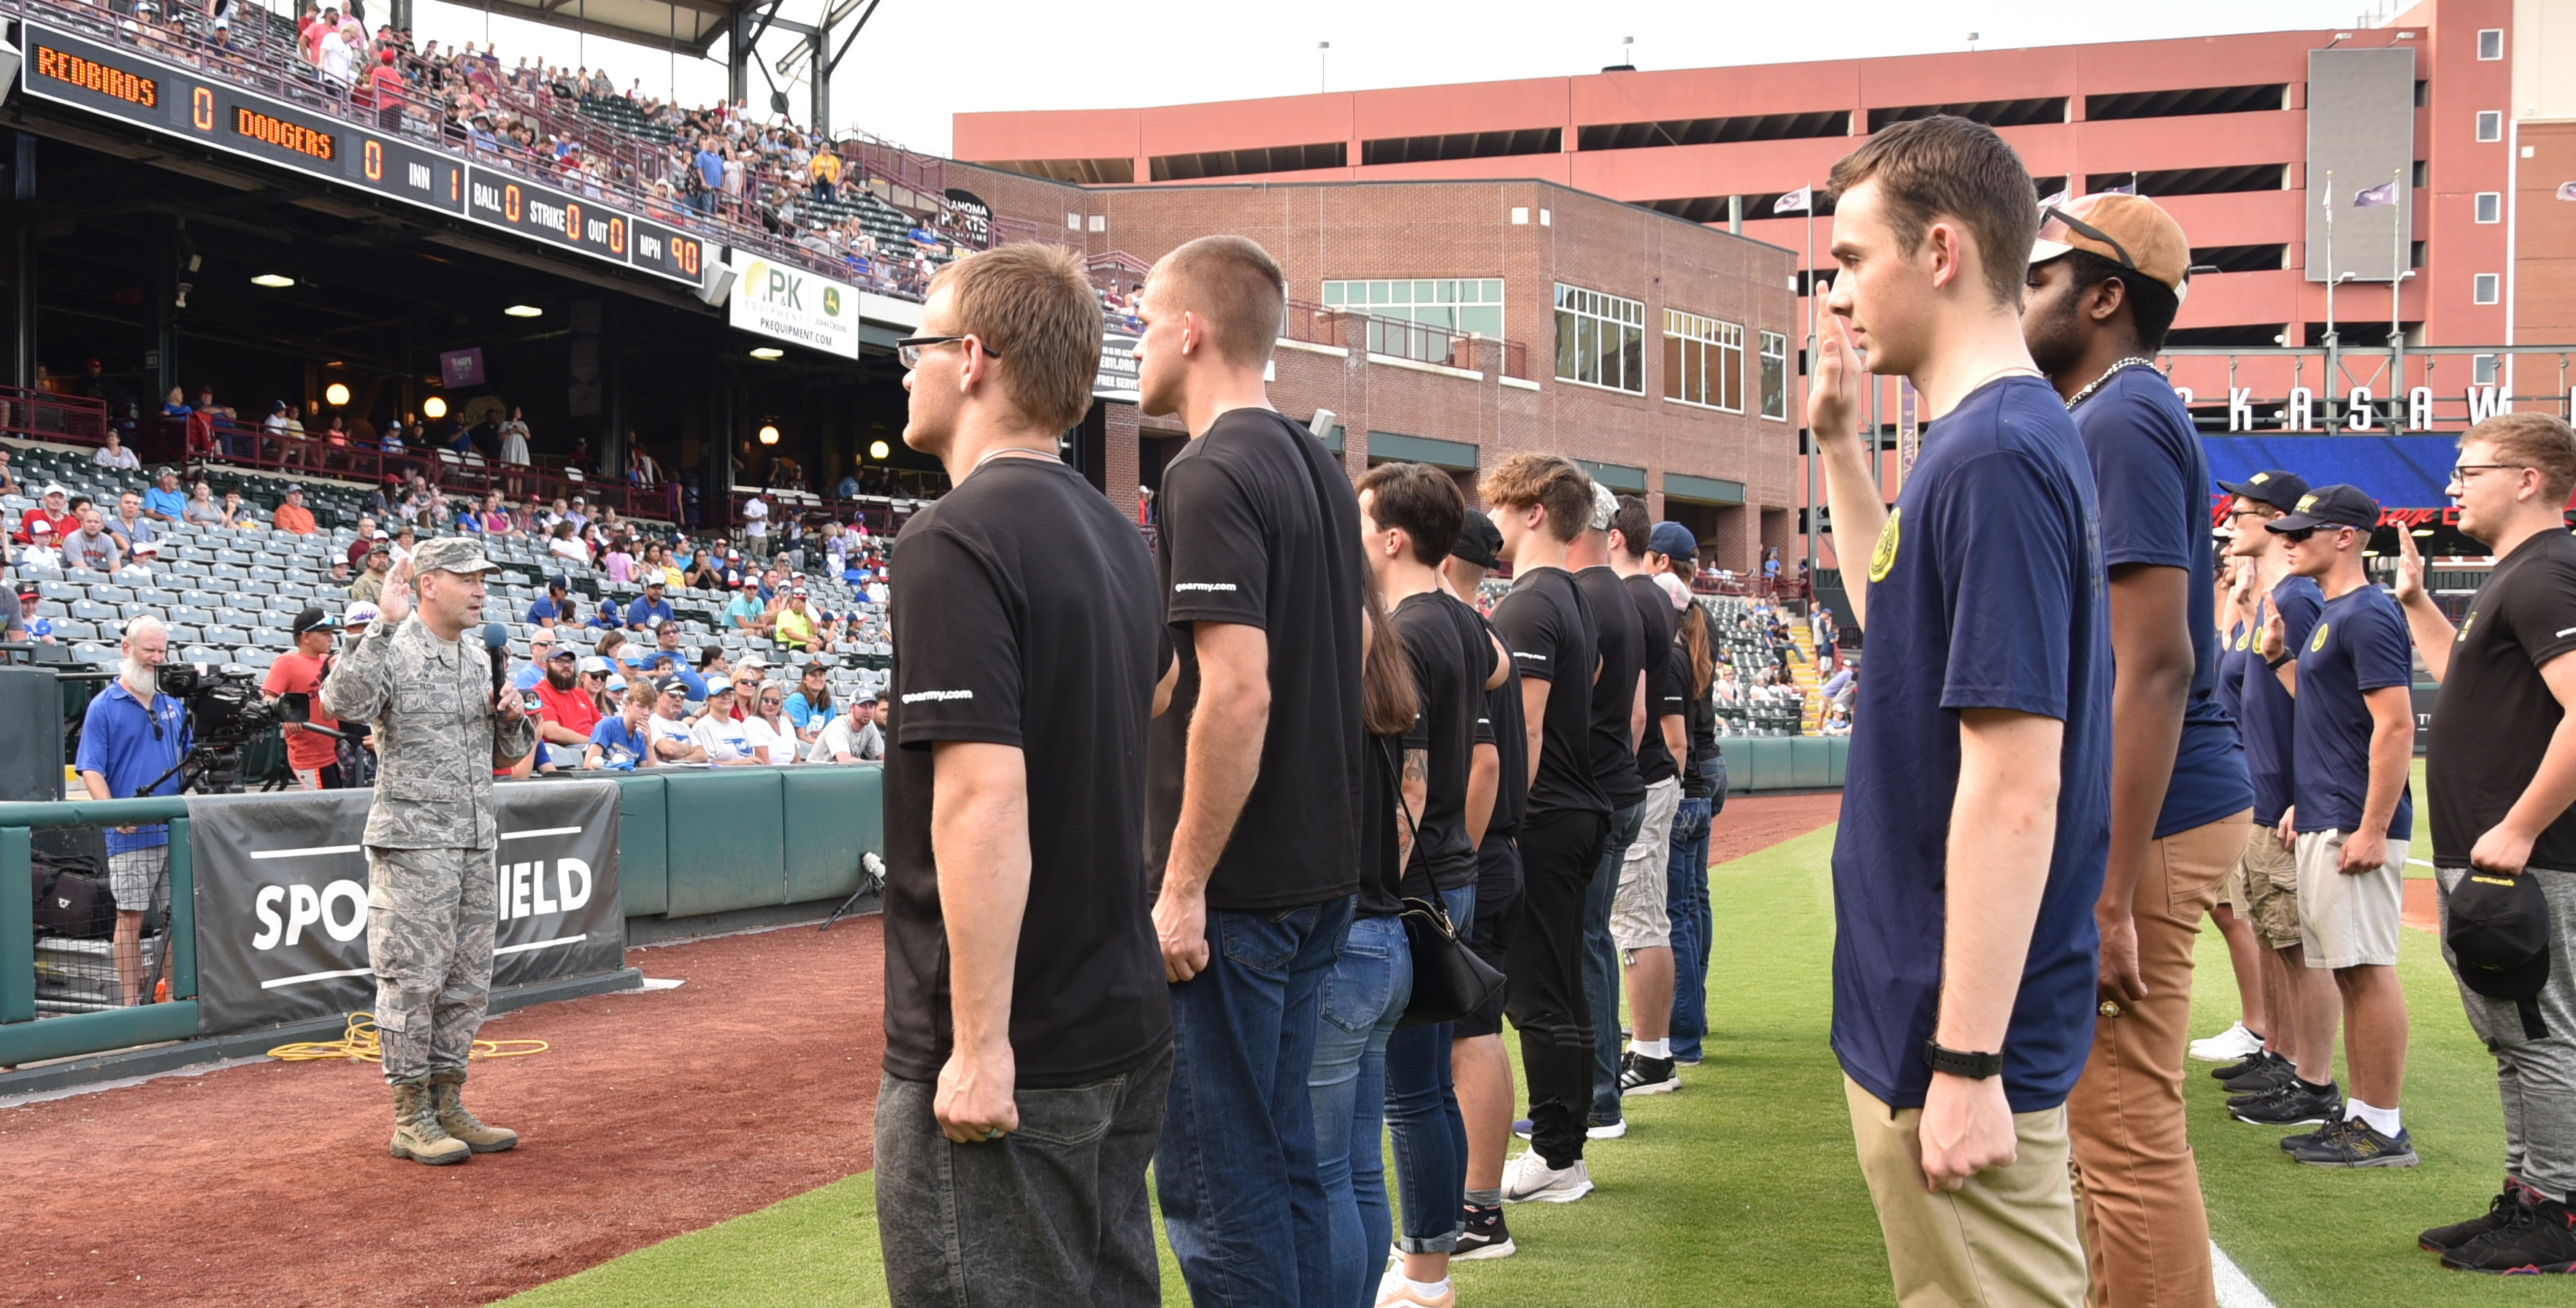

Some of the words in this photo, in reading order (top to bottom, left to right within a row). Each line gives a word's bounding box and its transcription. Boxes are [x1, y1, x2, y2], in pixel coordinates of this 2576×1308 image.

[38, 45, 156, 107] REDBIRDS
[193, 86, 213, 131] 0
[239, 108, 331, 160] DODGERS
[365, 139, 382, 180] 0
[409, 162, 430, 191] INN
[451, 169, 458, 201] 1
[474, 182, 501, 212] BALL
[505, 184, 521, 223] 0
[530, 200, 565, 232] STRIKE
[567, 204, 580, 240] 0
[588, 219, 608, 244] OUT
[610, 218, 624, 254] 0
[640, 234, 661, 260] MPH
[670, 236, 698, 275] 90
[745, 300, 802, 323] EQUIPMENT
[760, 317, 832, 347] PKEQUIPMENT.COM
[1100, 355, 1136, 372] E811.ORG
[1097, 374, 1115, 388] FREE
[1116, 377, 1138, 390] SERVI
[1175, 582, 1237, 593] goarmy.com
[902, 690, 973, 704] goarmy.com
